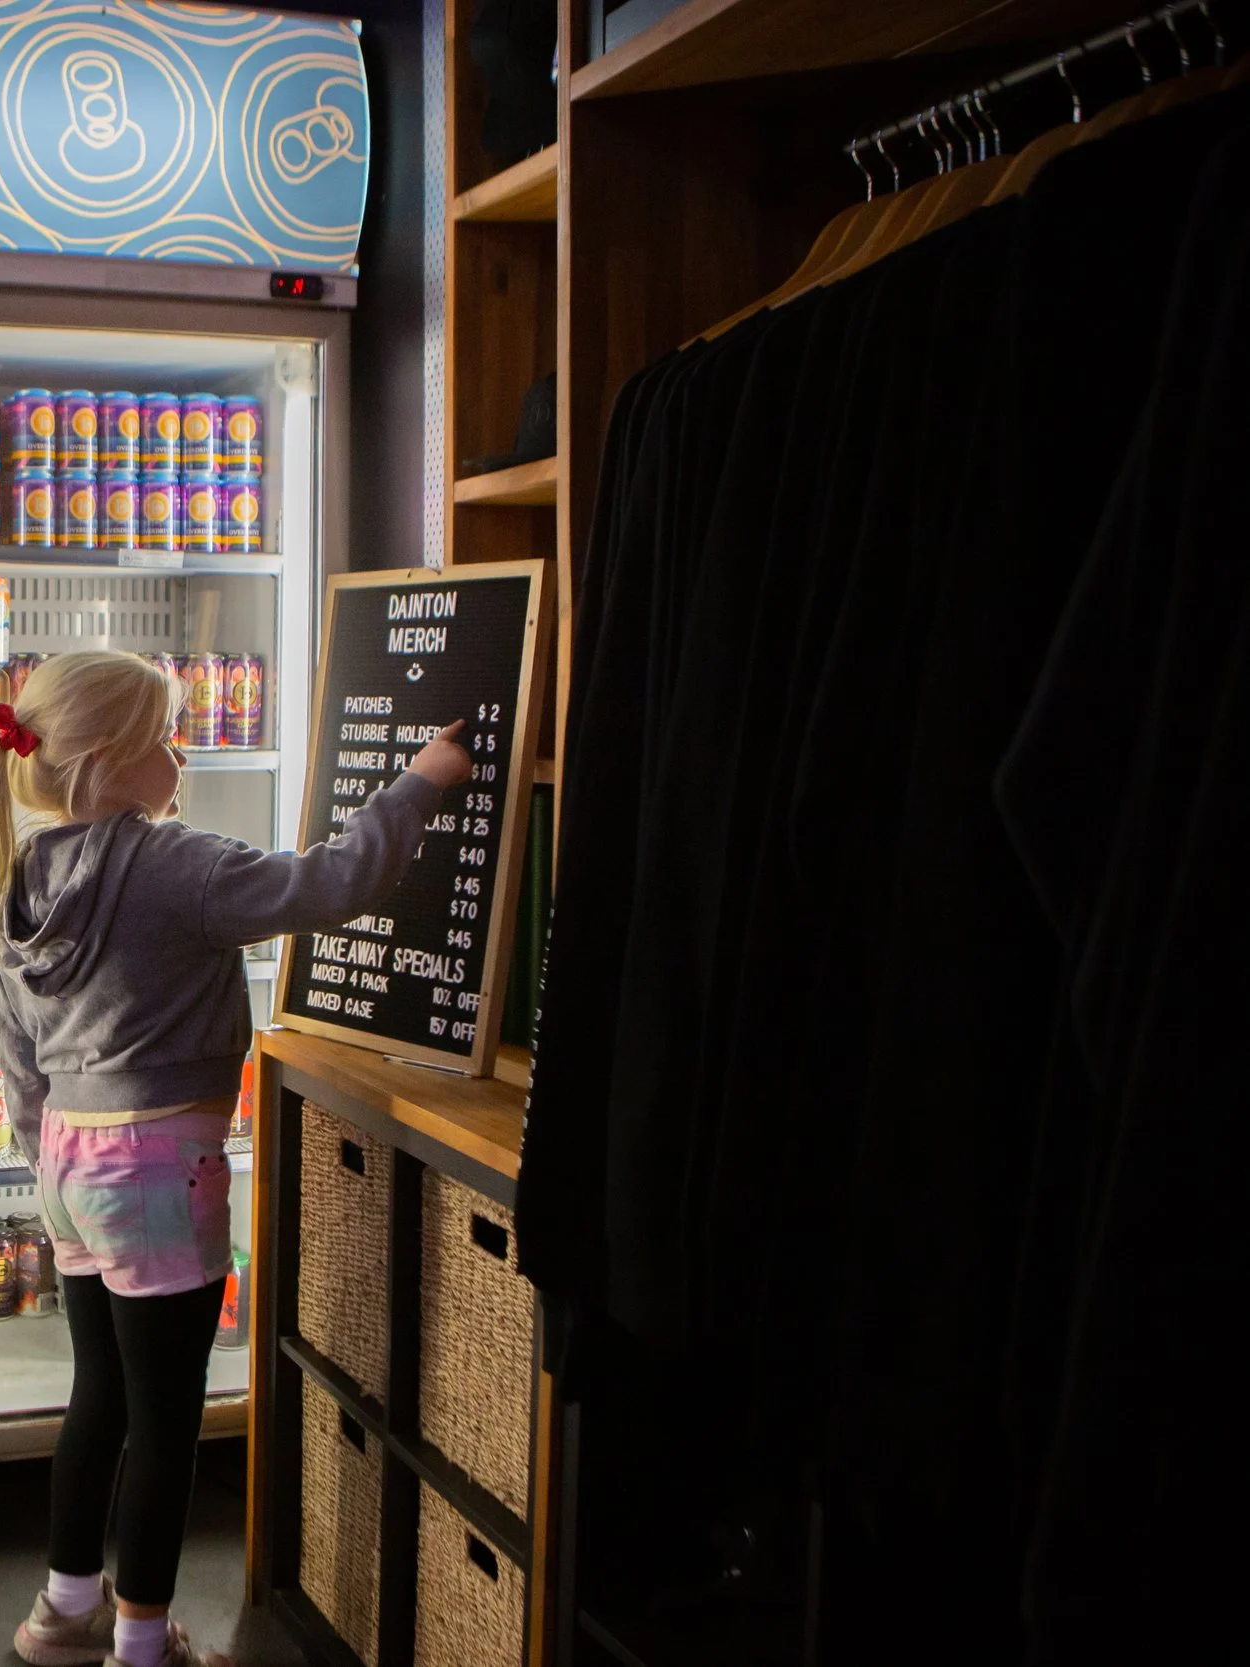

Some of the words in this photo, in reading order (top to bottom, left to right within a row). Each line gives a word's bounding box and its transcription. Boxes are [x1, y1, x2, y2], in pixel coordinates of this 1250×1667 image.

[388, 591, 458, 621] DAINTON
[388, 627, 448, 653] MERCH
[344, 696, 393, 715] PATCHES
[341, 723, 390, 743] STUBBIE
[396, 725, 446, 744] HOLDER
[338, 751, 386, 770] NUMBER
[471, 762, 497, 783] $10
[334, 778, 366, 797] CAPS
[466, 792, 494, 813] $35
[459, 845, 486, 867] $40
[454, 875, 481, 896] $45
[450, 899, 478, 920] $70
[343, 914, 395, 936] ROWLER
[447, 929, 472, 949] $45
[393, 947, 465, 985] SPECIALS
[311, 962, 346, 985] MIXED
[349, 969, 358, 987] 4
[361, 972, 390, 994] PACK
[432, 986, 452, 1007] 10%
[457, 992, 480, 1012] OFF
[307, 989, 342, 1011] MIXED
[345, 998, 375, 1019] CASE
[452, 1021, 476, 1042] OFF
